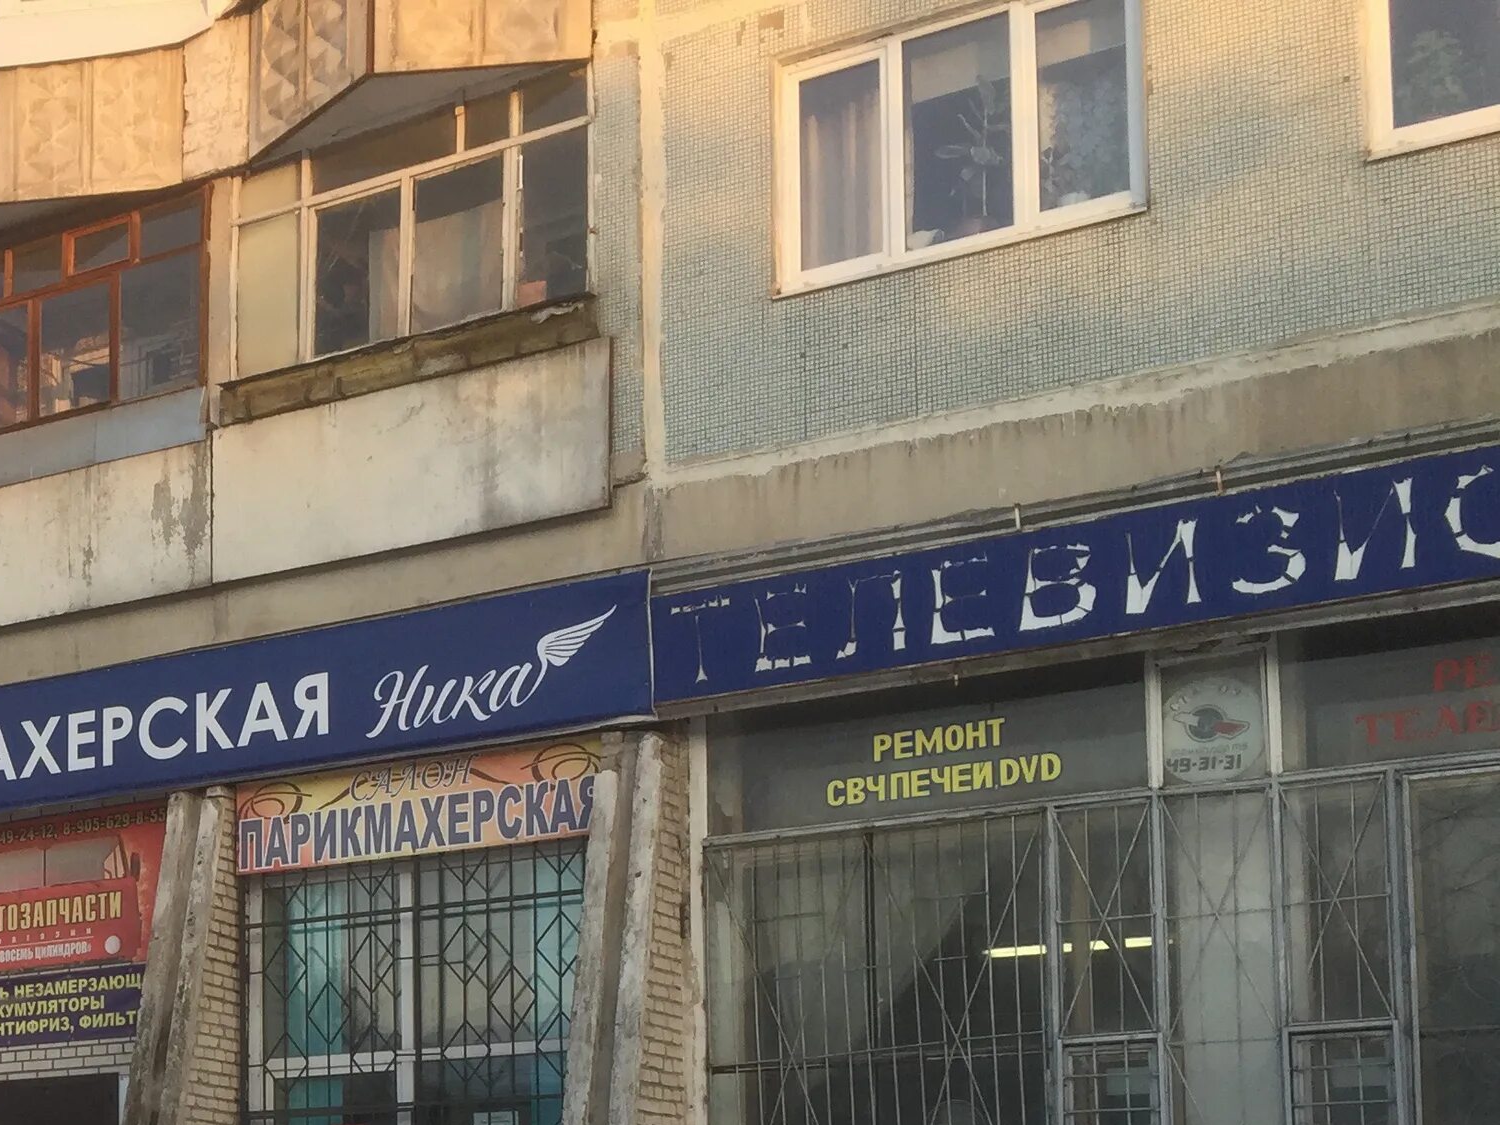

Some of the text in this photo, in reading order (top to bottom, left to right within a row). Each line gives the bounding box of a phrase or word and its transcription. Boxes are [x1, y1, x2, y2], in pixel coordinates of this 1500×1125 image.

[365, 663, 548, 739] Ника
[873, 717, 1005, 762] РЕМОНТ
[350, 754, 479, 801] САЛОН
[239, 775, 597, 871] ПАРИКМАХЕРСКАЯ
[14, 973, 142, 998] НЕЗАМЕРЗАЮЩ
[79, 1009, 137, 1029] ФИЛЬТ
